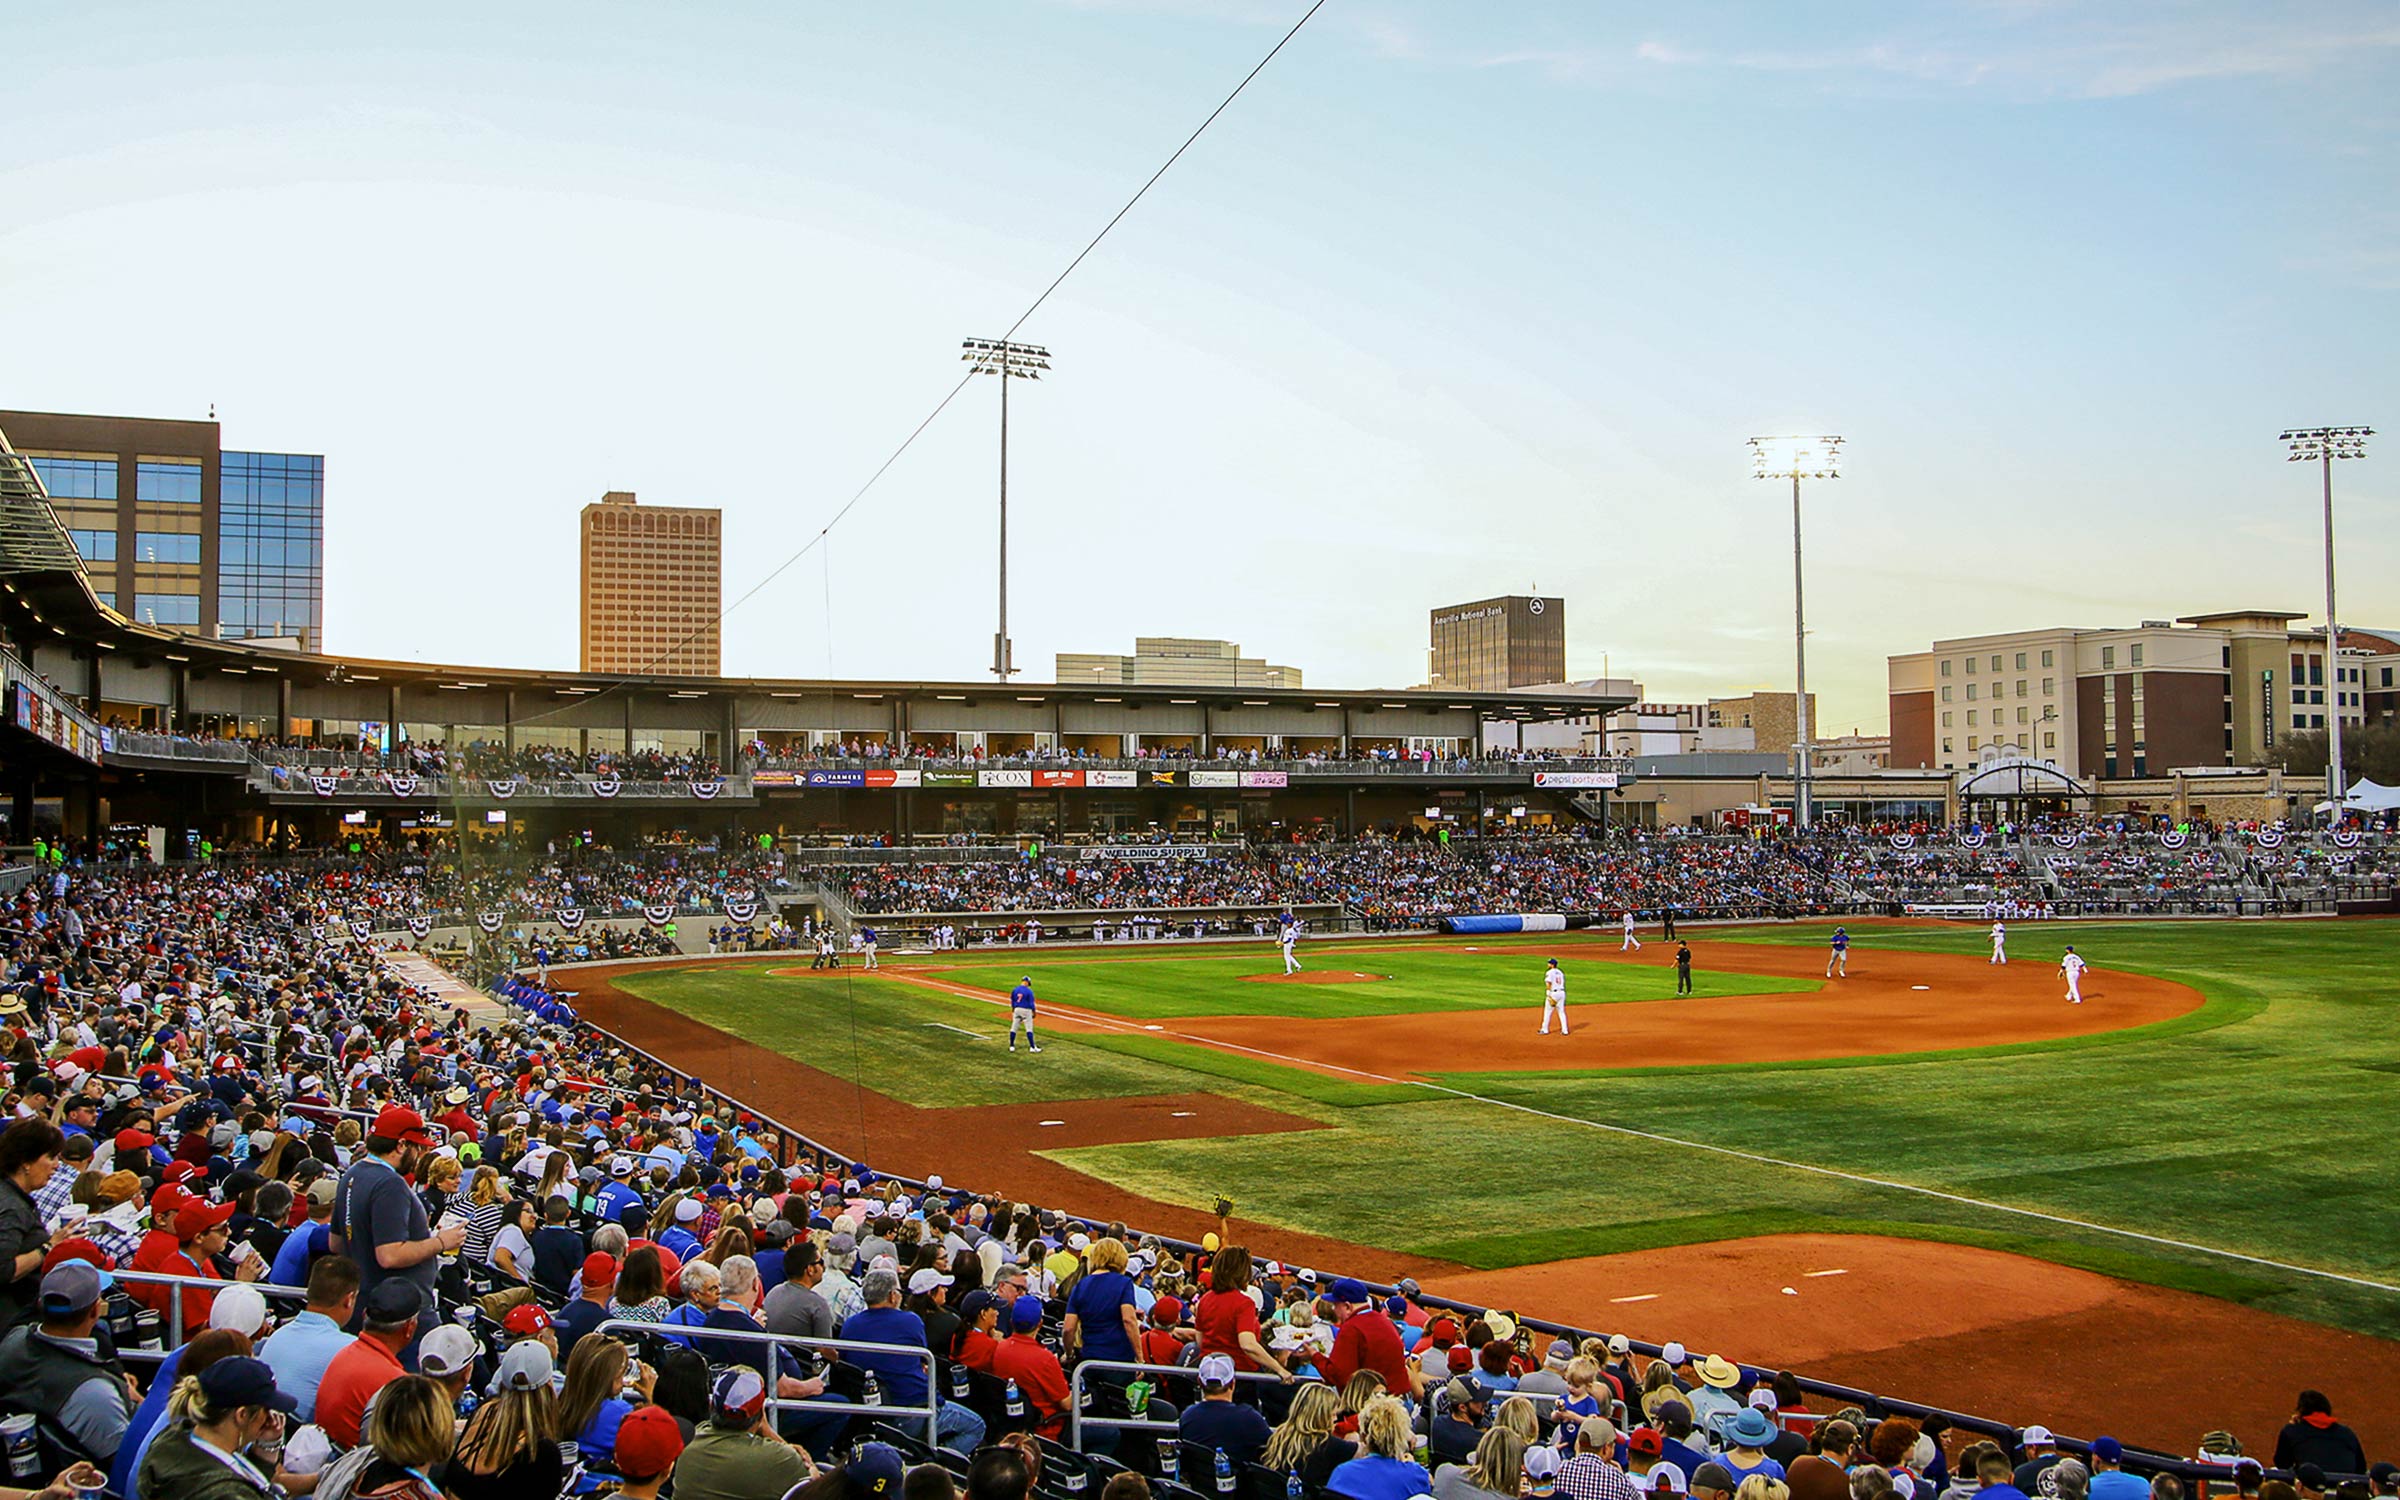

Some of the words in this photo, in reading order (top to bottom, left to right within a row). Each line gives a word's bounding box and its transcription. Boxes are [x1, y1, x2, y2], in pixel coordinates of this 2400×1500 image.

[1461, 608, 1486, 621] National
[1487, 606, 1504, 617] Bank
[996, 772, 1027, 783] COX
[1548, 775, 1571, 784] pepsi
[1572, 775, 1595, 784] party
[1104, 848, 1158, 858] WELDING
[1159, 848, 1205, 858] SUPPLY
[595, 1198, 609, 1217] 19
[873, 1477, 887, 1493] 3
